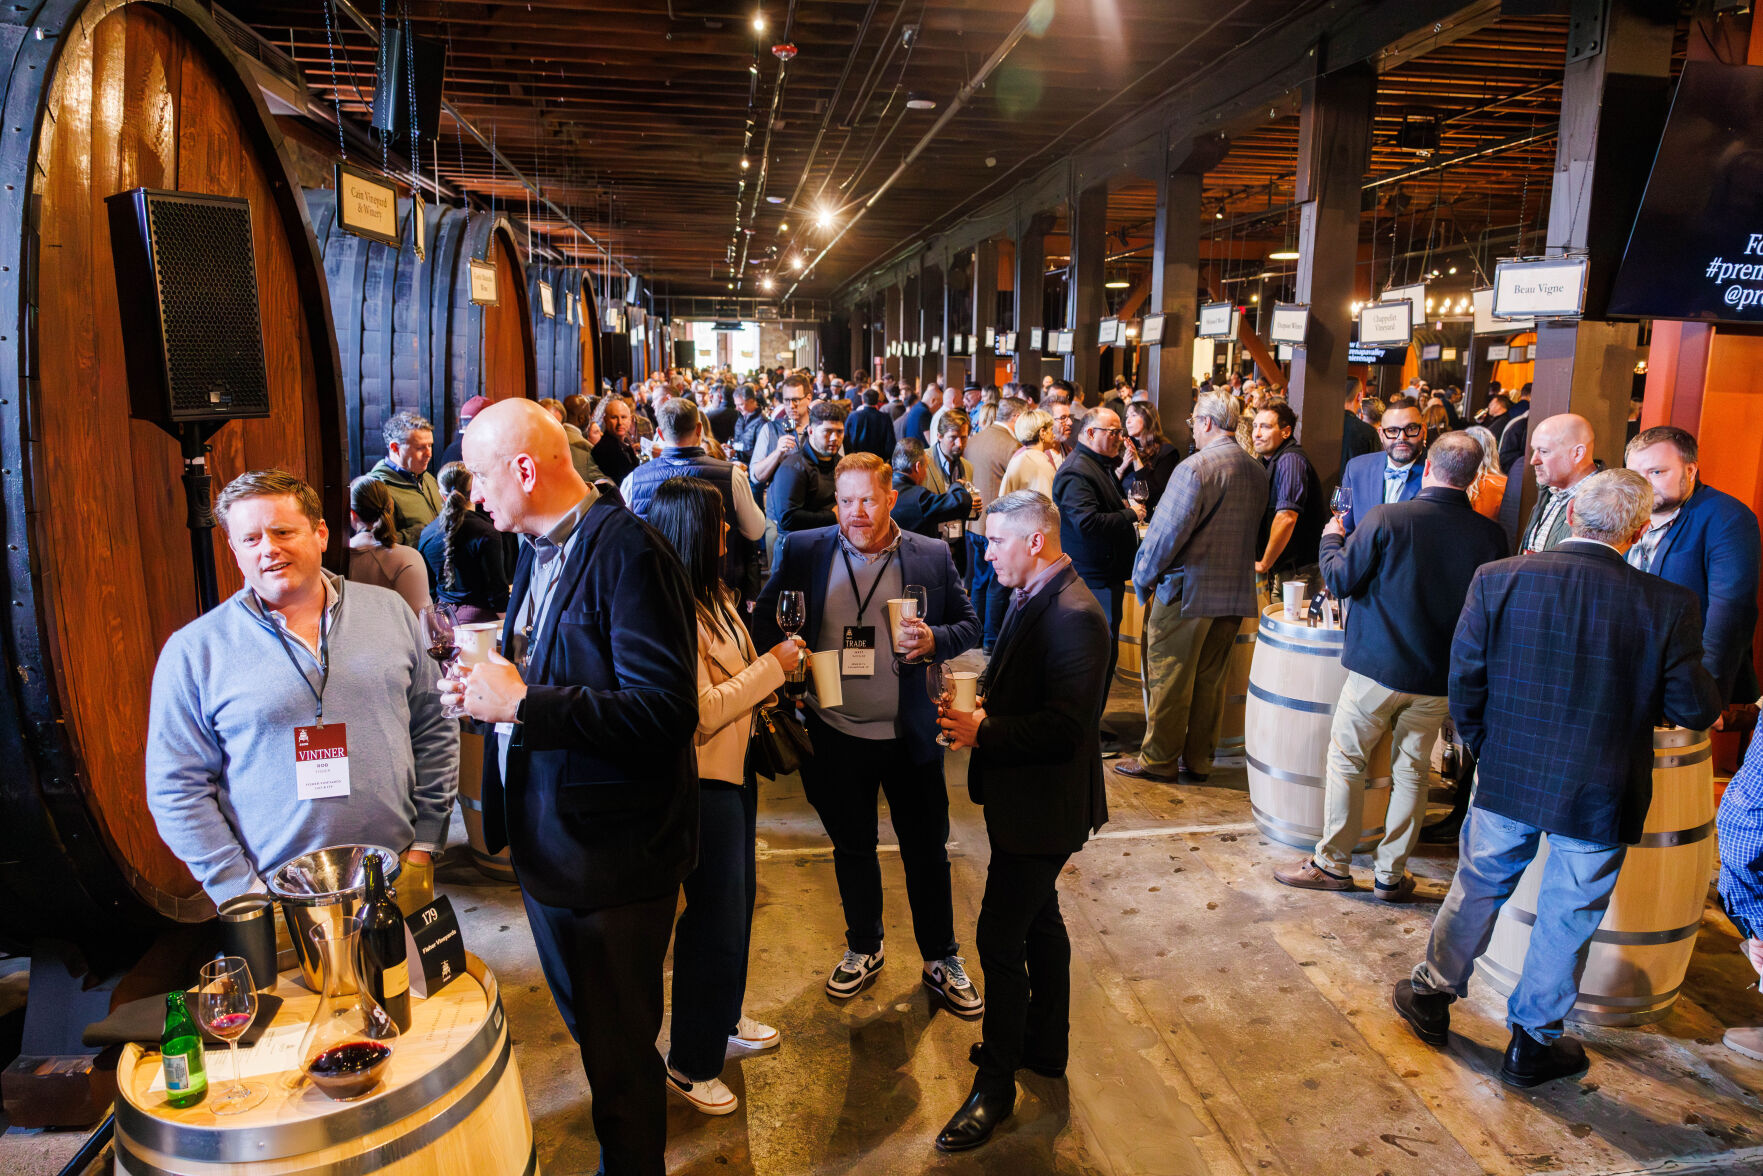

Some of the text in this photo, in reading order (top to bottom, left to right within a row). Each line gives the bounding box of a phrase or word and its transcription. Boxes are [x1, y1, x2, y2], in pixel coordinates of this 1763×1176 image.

[350, 187, 388, 209] Cain Vineyard
[363, 204, 382, 222] Winery
[1514, 283, 1564, 296] Beau Vigne
[1725, 285, 1763, 309] @pr
[846, 640, 867, 648] TRADE
[299, 747, 345, 760] VINTNER
[421, 907, 438, 926] 179
[422, 929, 457, 955] Fisher Vineyards
